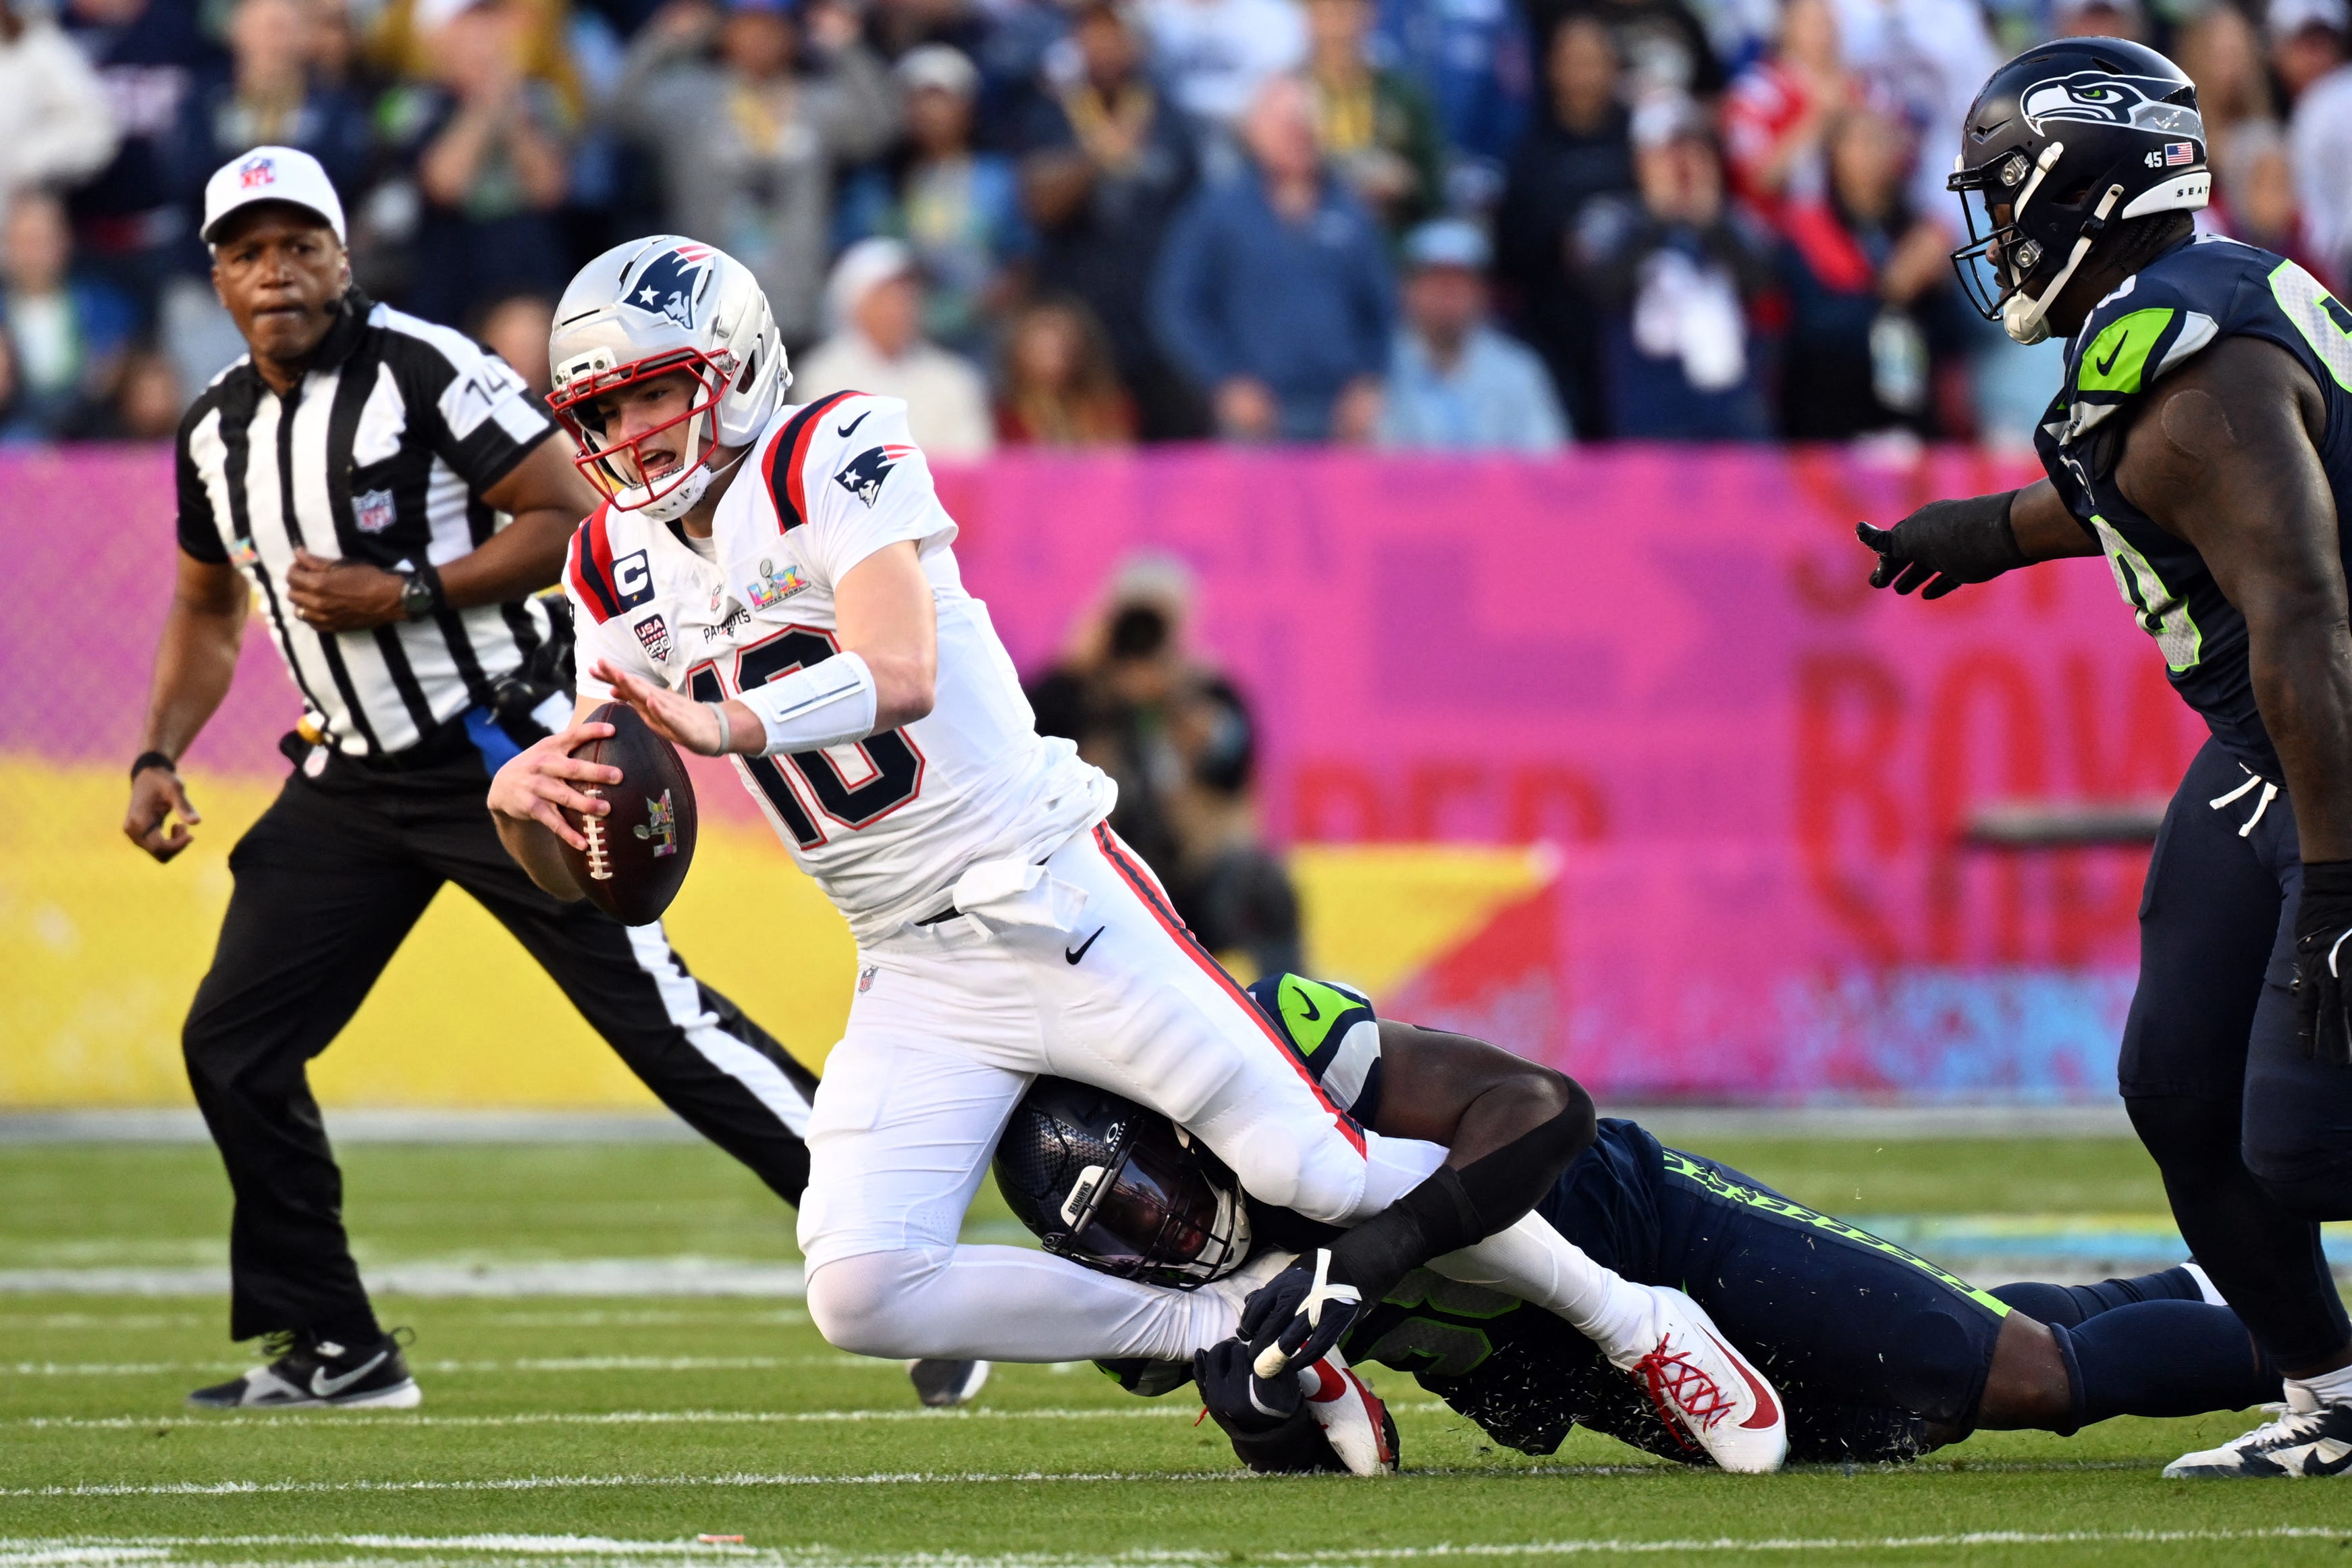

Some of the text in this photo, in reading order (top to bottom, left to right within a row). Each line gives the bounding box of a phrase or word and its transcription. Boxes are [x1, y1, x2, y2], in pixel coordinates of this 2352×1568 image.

[2144, 151, 2163, 168] 45
[241, 167, 275, 189] NFL
[614, 554, 649, 597] C
[636, 618, 664, 639] USA
[645, 636, 672, 657] 250
[686, 623, 926, 851] 10
[1109, 1120, 1127, 1153] OAKLEY
[1067, 1181, 1093, 1216] SEAHAWKS
